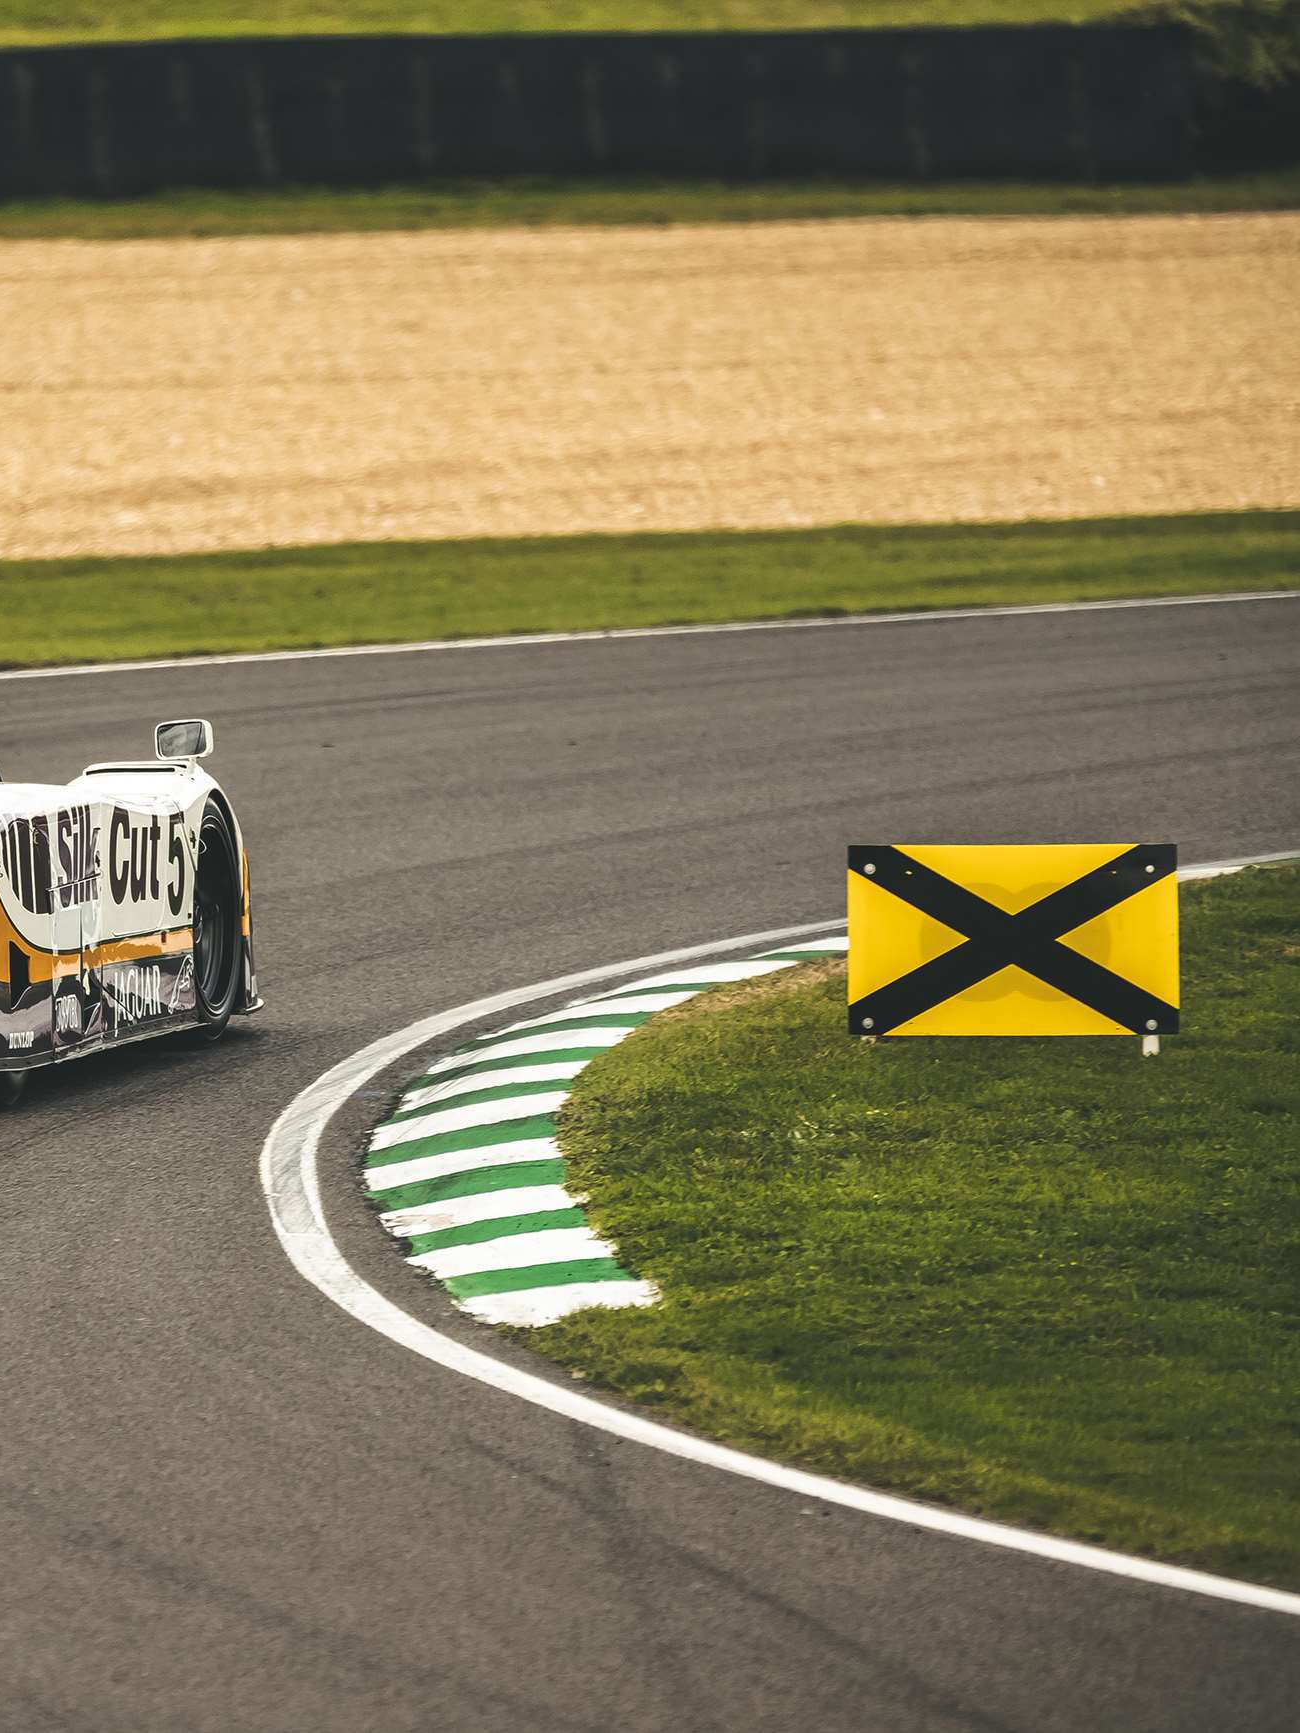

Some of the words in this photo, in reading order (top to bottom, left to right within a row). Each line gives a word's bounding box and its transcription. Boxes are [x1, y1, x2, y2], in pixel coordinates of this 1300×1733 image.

[57, 804, 100, 908] Silk
[109, 805, 160, 905] Cut
[167, 811, 185, 916] 5
[9, 1031, 34, 1049] DUNLOP
[113, 965, 161, 1037] JAGUAR
